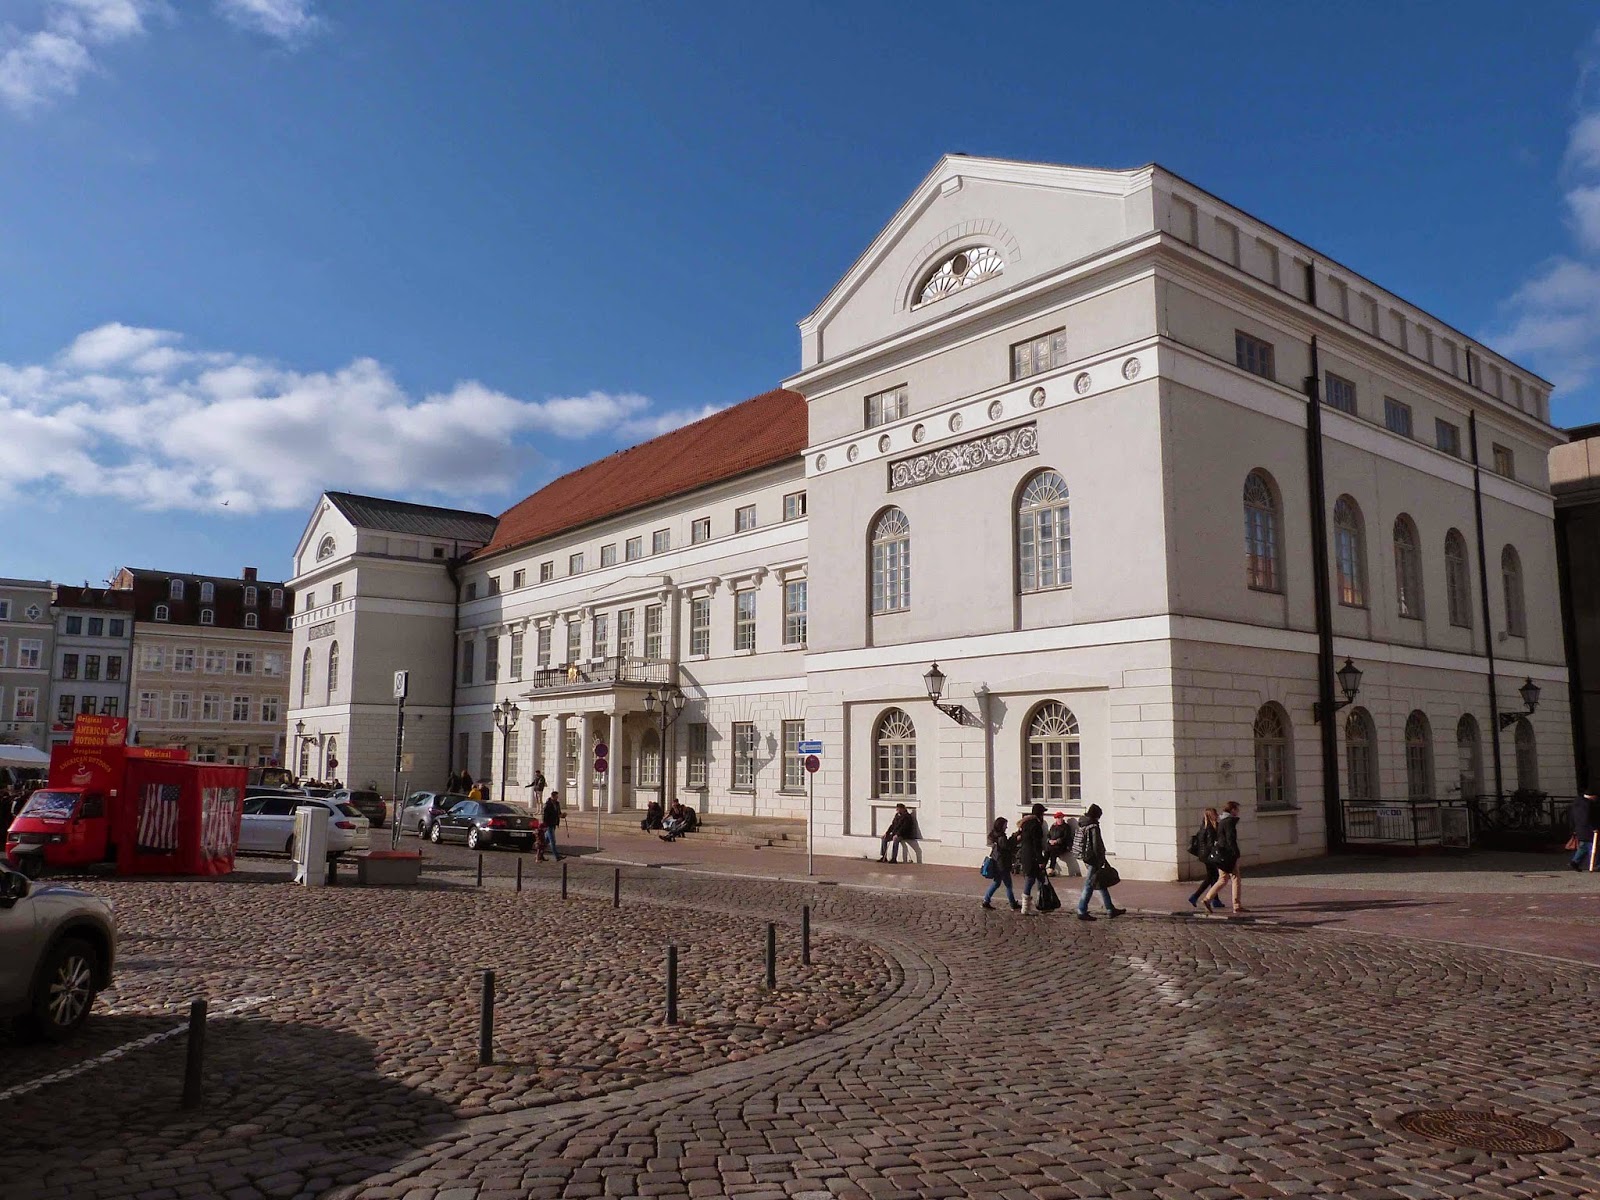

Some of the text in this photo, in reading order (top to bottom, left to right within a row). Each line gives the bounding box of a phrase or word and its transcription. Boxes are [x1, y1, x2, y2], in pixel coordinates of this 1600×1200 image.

[77, 716, 103, 724] Original
[75, 726, 110, 736] AMERICAN
[74, 736, 105, 745] HOTDOGS
